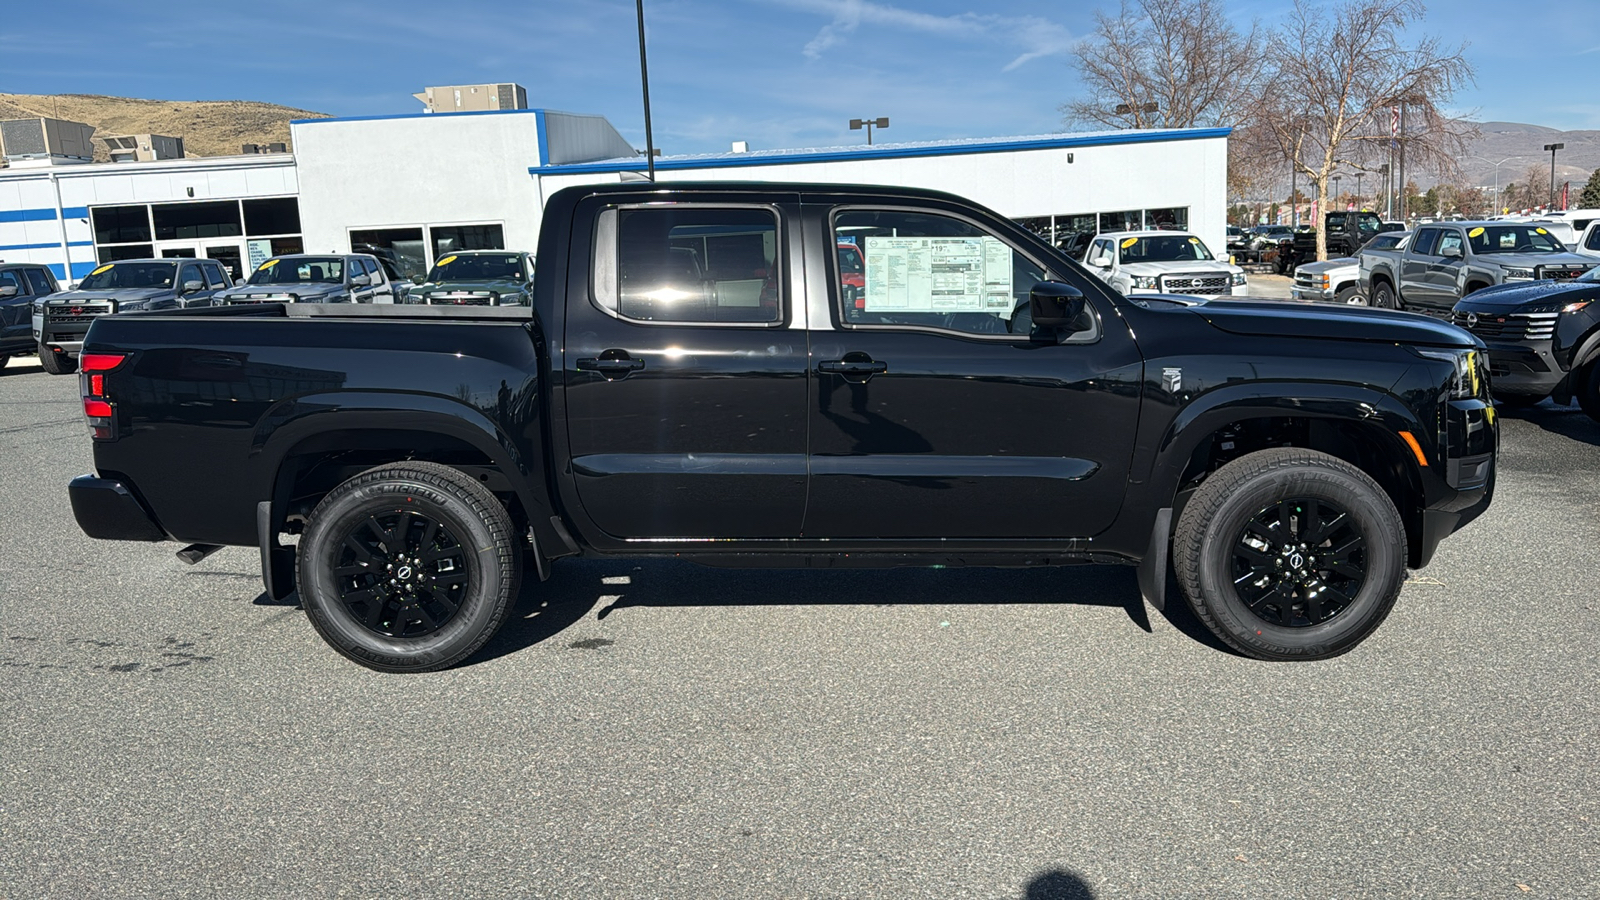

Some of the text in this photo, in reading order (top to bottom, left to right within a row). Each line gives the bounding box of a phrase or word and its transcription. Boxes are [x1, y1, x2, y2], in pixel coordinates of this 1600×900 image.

[383, 485, 446, 505] MICHELIN
[1303, 471, 1364, 496] MICHELIN
[1240, 632, 1303, 655] MICHELIN
